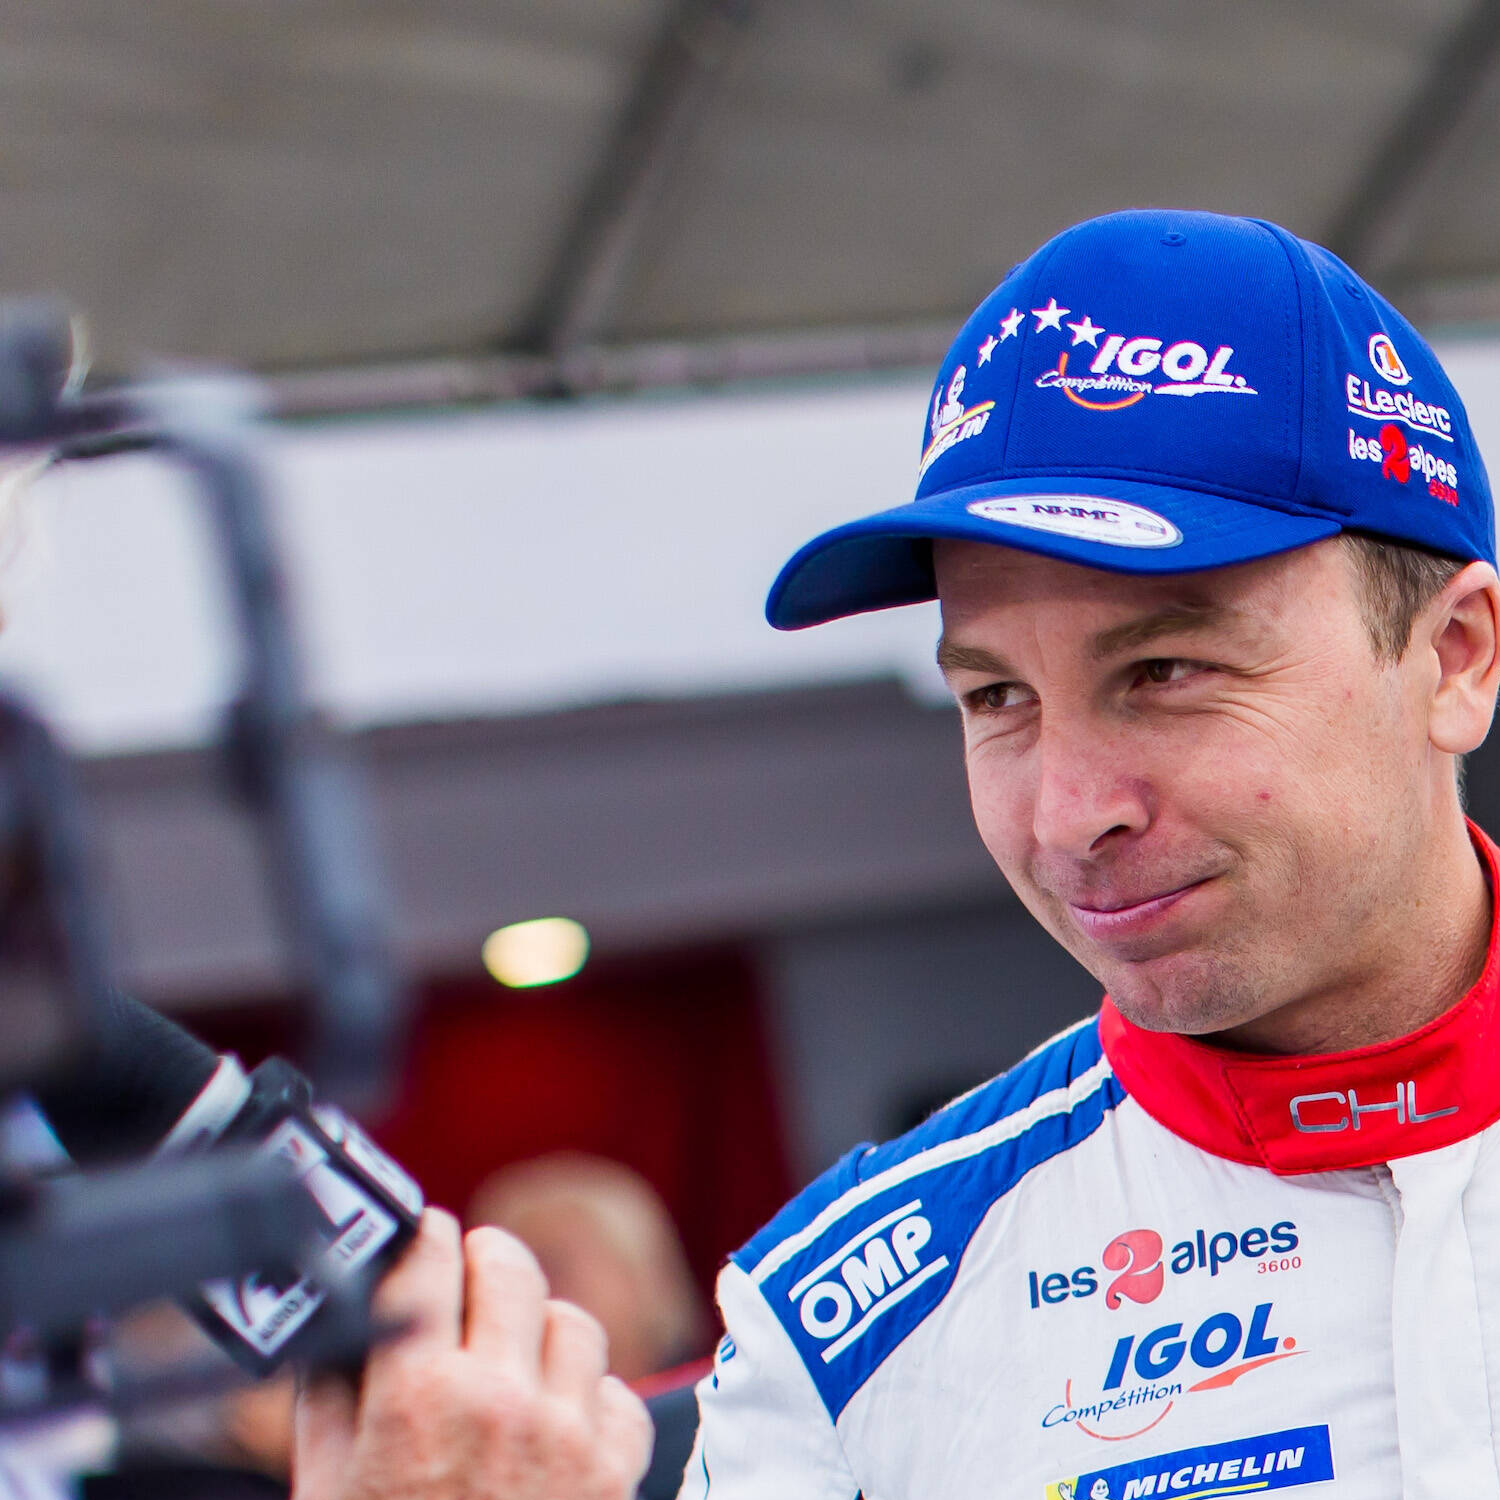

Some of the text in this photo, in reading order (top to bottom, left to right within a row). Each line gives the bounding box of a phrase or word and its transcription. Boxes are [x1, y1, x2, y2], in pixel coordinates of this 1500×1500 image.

[1408, 444, 1458, 489] alpes
[1289, 1080, 1459, 1133] CHL
[800, 1215, 932, 1339] OMP
[1029, 1220, 1300, 1310] les 2 alpes
[1257, 1256, 1302, 1275] 3600
[1042, 1381, 1183, 1430] Compétition
